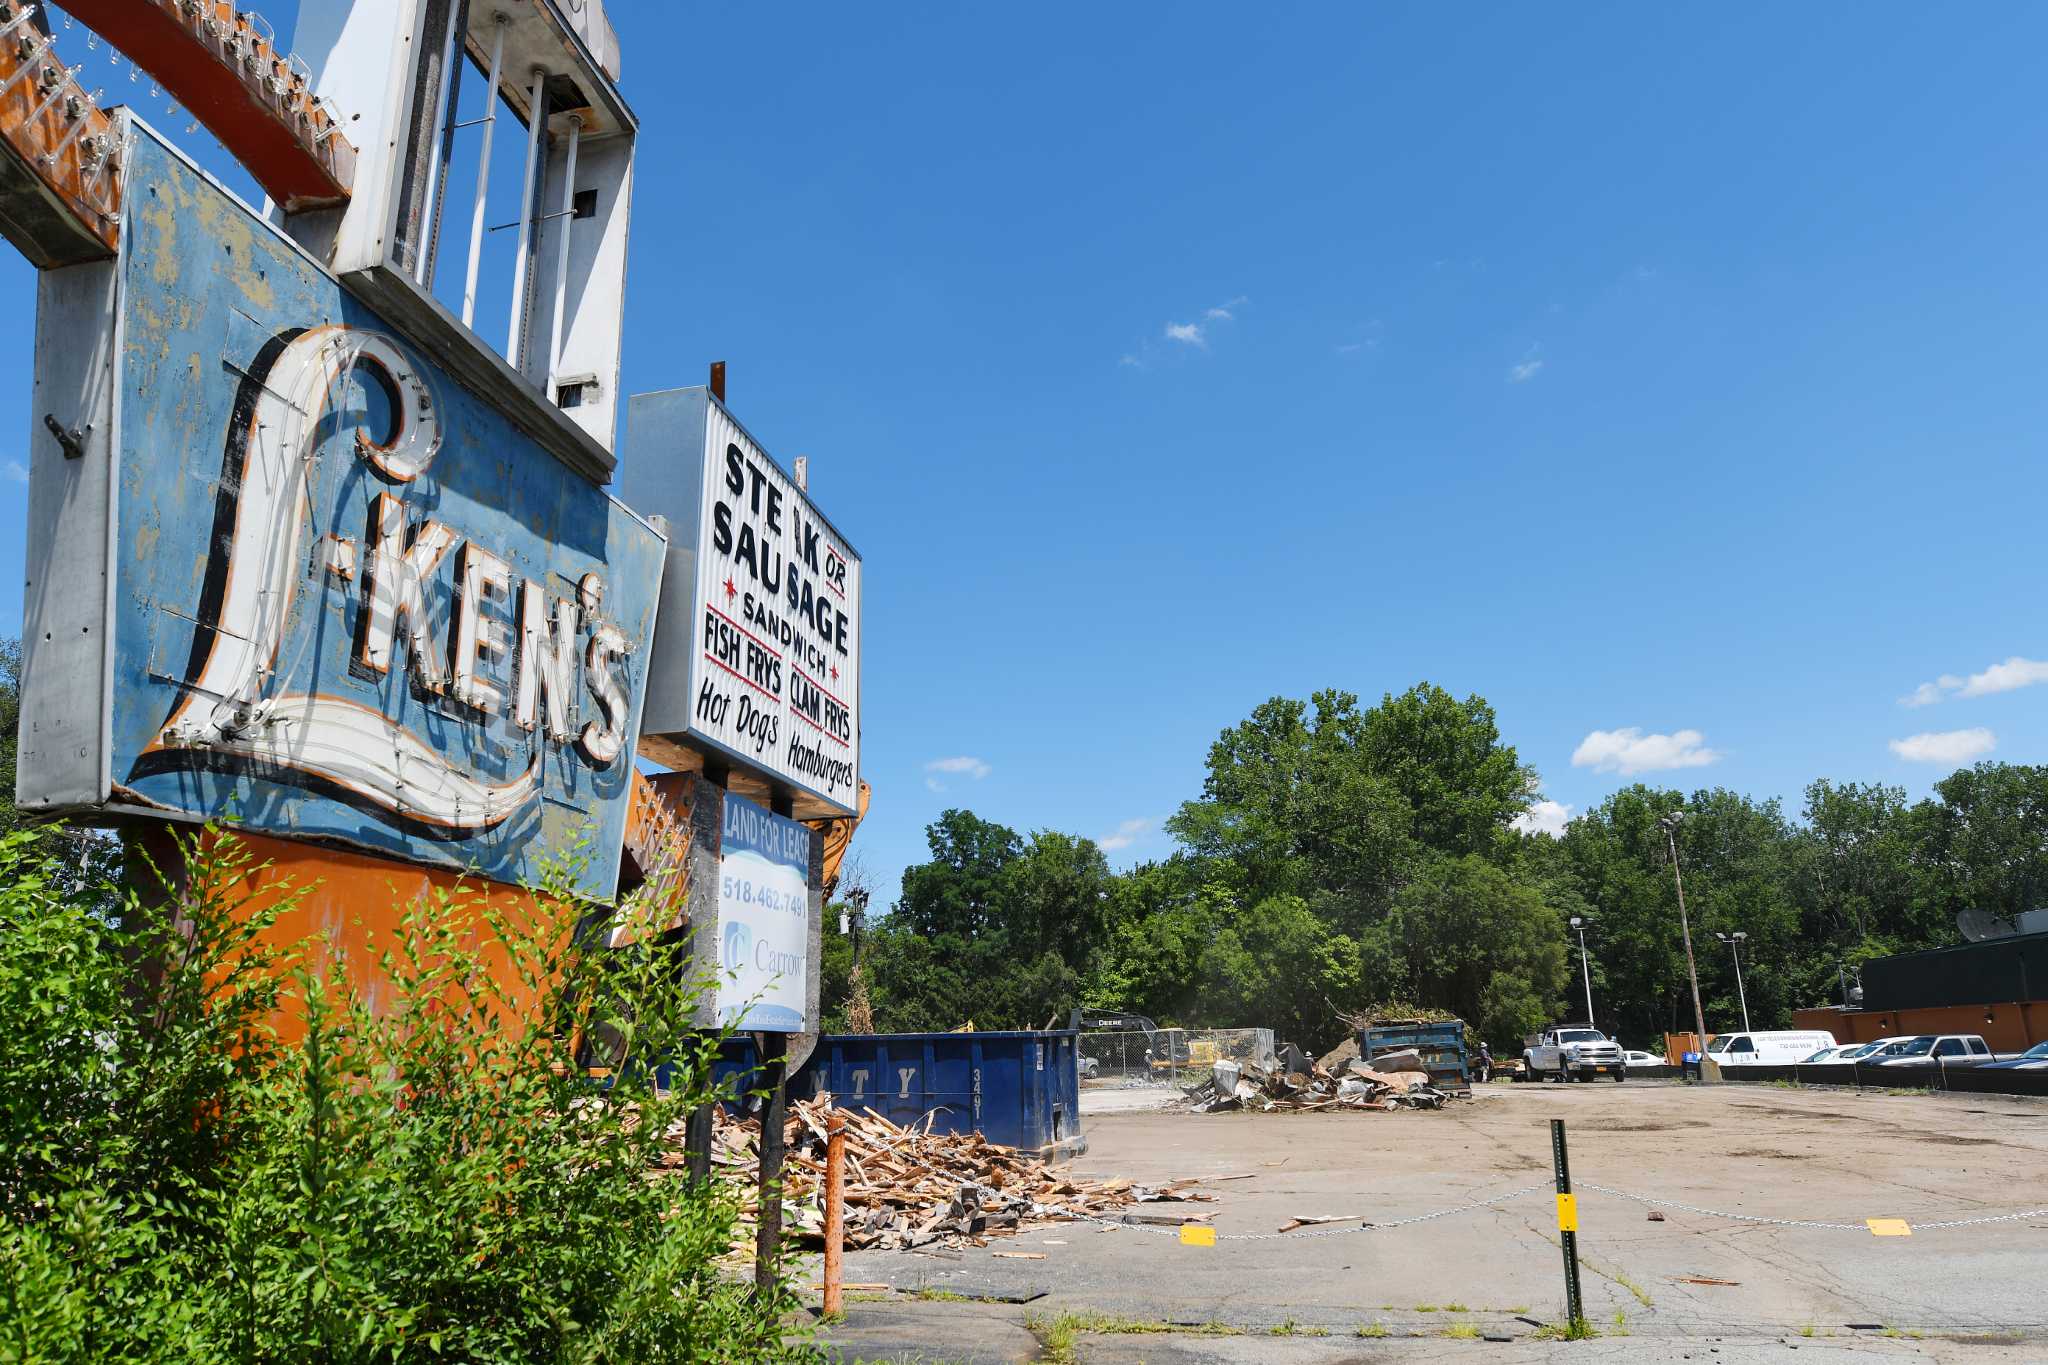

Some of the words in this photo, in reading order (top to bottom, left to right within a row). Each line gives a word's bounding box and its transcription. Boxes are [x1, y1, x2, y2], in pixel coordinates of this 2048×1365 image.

[714, 501, 849, 656] SAUSAGE
[826, 553, 846, 593] OR
[704, 611, 740, 669] FISH
[746, 640, 781, 694] FRYS
[743, 592, 826, 678] SANDWICH
[696, 676, 731, 726] Hot
[736, 694, 779, 752] Dogs
[790, 671, 820, 724] CLAM
[824, 700, 850, 741] FRYS
[787, 731, 853, 793] Hamburgers
[723, 800, 758, 845] LAND
[760, 815, 780, 857] FOR
